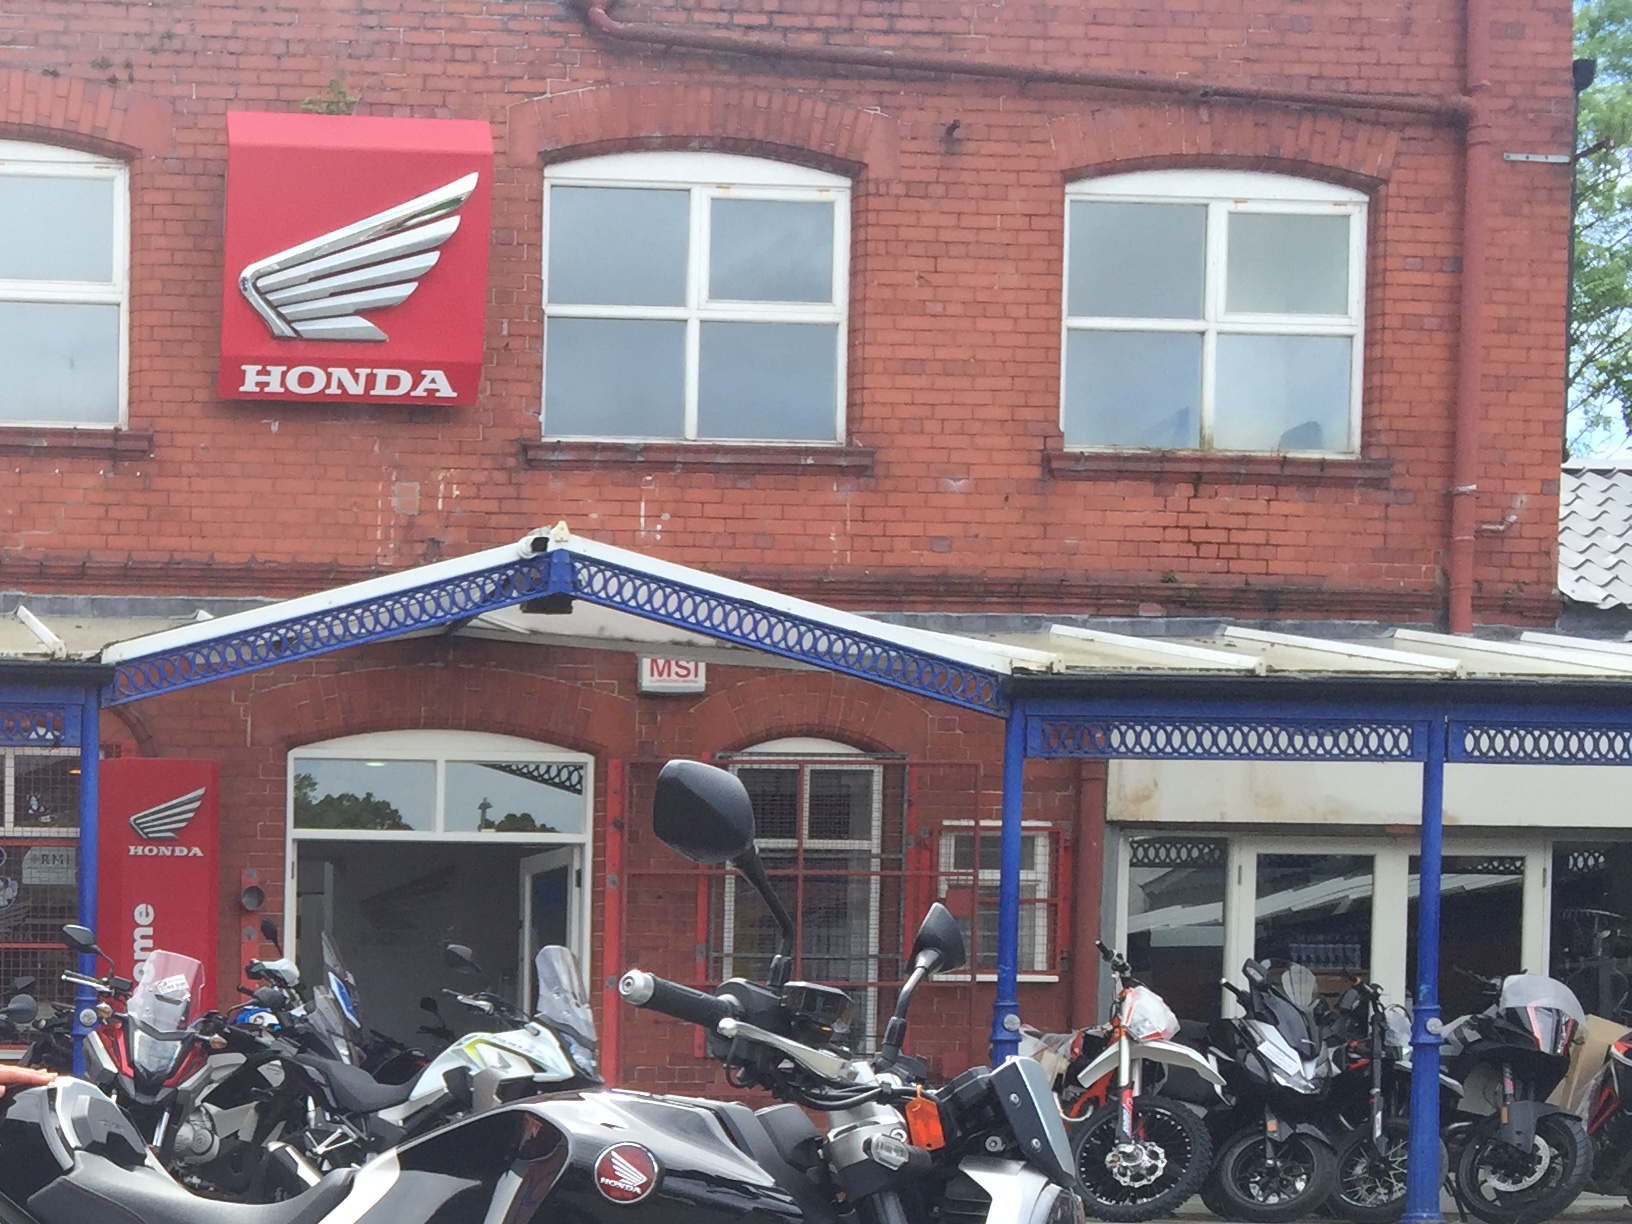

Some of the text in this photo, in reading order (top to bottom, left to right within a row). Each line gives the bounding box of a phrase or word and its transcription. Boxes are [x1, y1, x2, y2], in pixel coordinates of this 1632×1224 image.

[239, 365, 458, 398] HONDA
[649, 658, 699, 679] MSI
[128, 846, 204, 857] HONDA
[600, 1177, 642, 1195] HONDA
